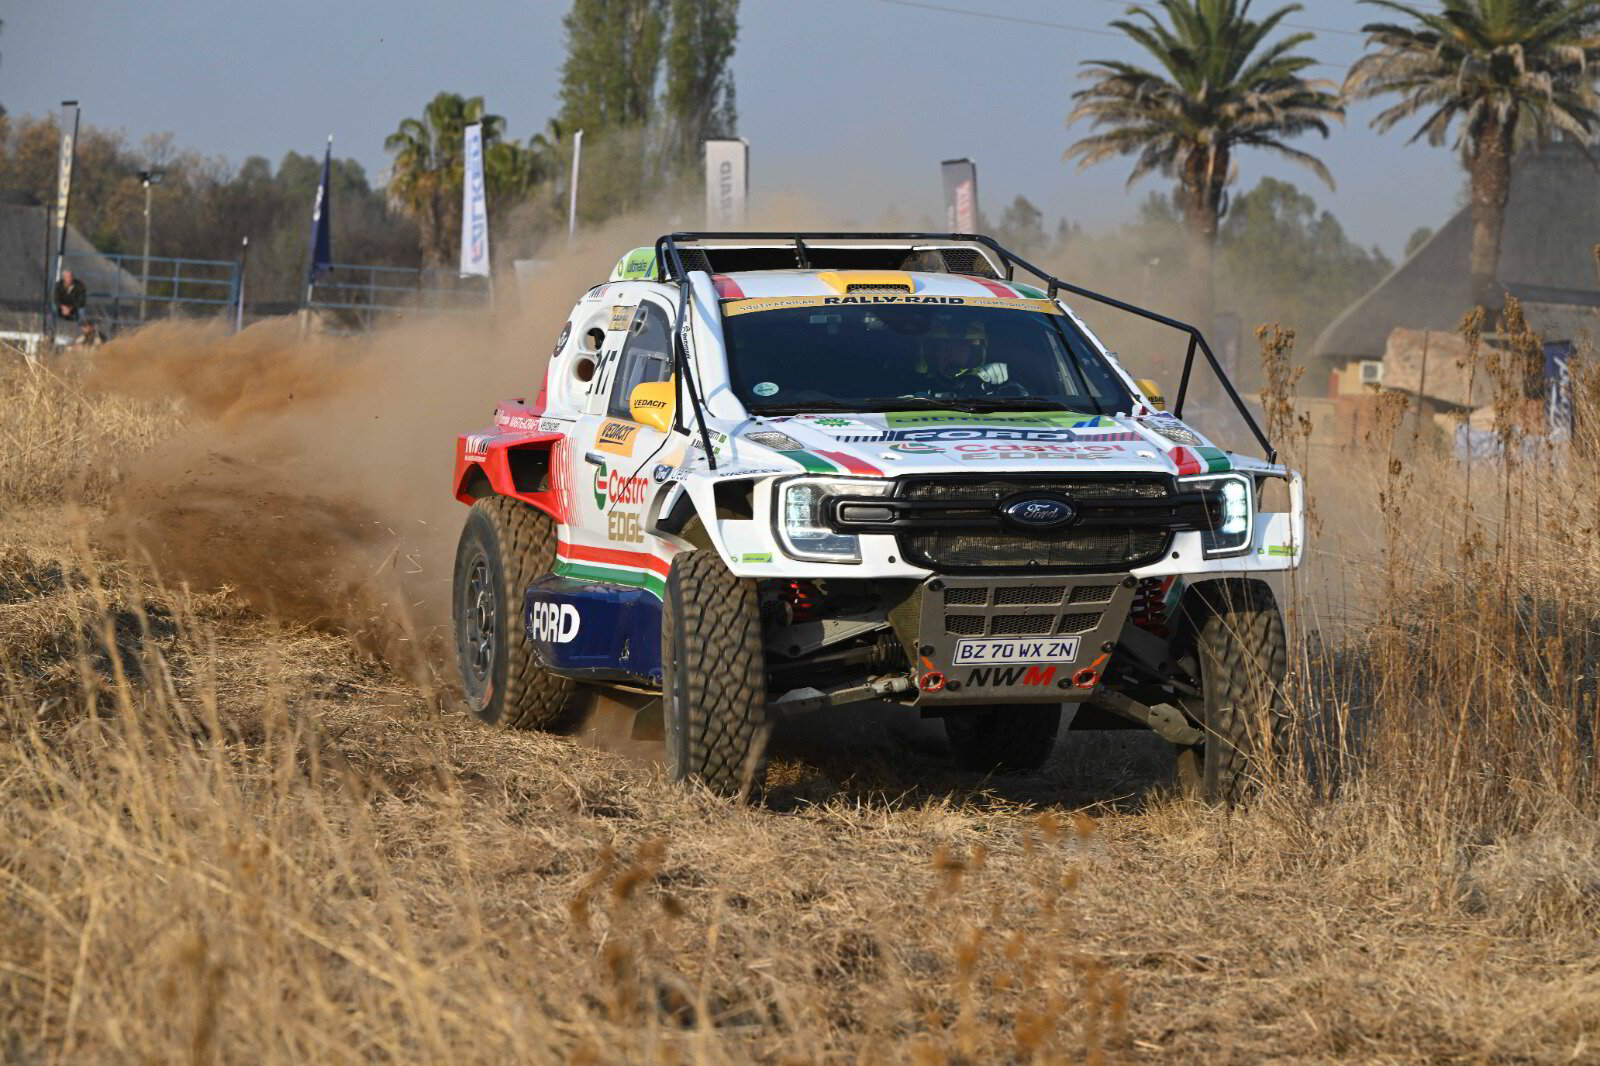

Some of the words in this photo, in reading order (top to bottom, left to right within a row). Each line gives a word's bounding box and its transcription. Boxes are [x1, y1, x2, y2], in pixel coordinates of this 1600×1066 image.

[824, 295, 964, 306] RALLY-RAID
[633, 398, 668, 409] VEDACIT
[601, 422, 636, 442] VEDACIT
[903, 430, 1069, 440] FORD
[954, 443, 1126, 453] Castrol
[961, 451, 1112, 461] EDGE
[1023, 503, 1059, 519] Ford
[532, 601, 581, 644] FORD
[960, 644, 987, 659] BZ
[991, 644, 1014, 658] 70
[1019, 643, 1043, 658] WX
[1046, 642, 1073, 657] ZN
[965, 666, 1057, 687] NWM
